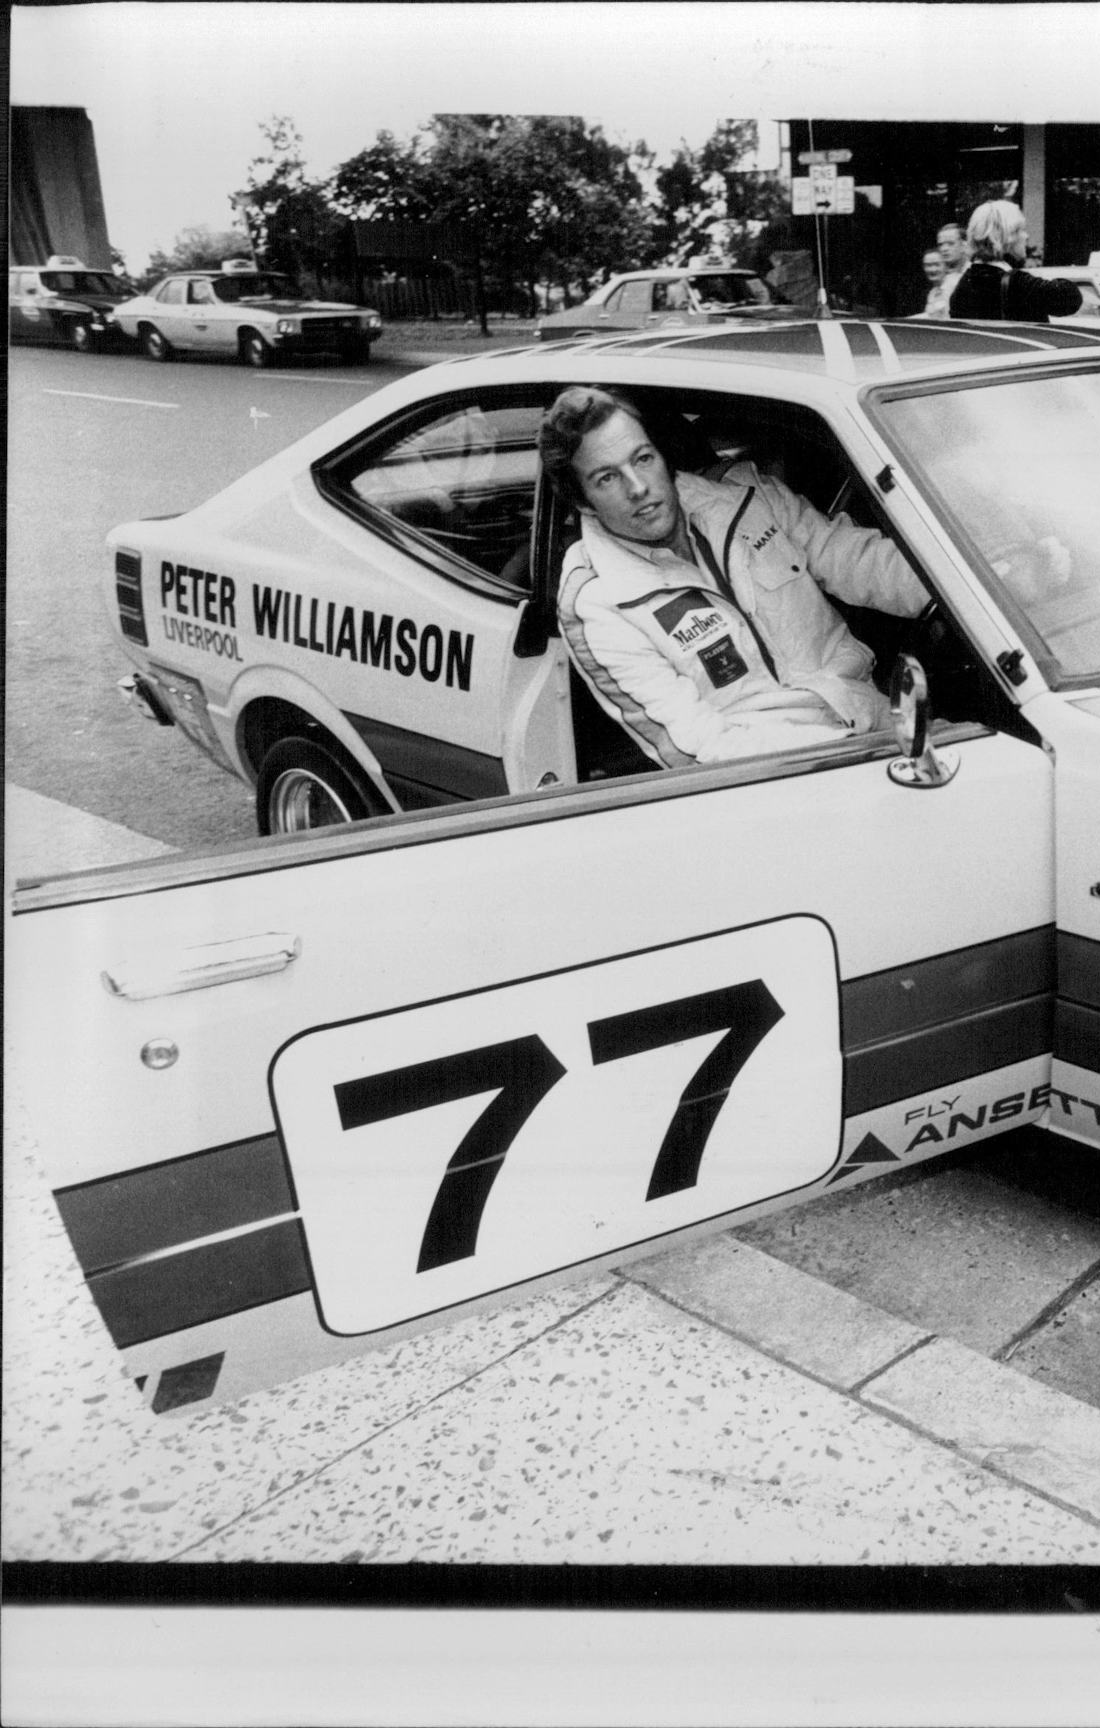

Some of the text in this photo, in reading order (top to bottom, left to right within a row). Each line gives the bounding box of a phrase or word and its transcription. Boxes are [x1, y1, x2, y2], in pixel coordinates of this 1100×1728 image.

[161, 561, 475, 692] PETER WILLIAMSON
[162, 615, 243, 662] LIVERPOOL
[333, 978, 786, 1274] 77
[904, 1095, 961, 1125] FLY
